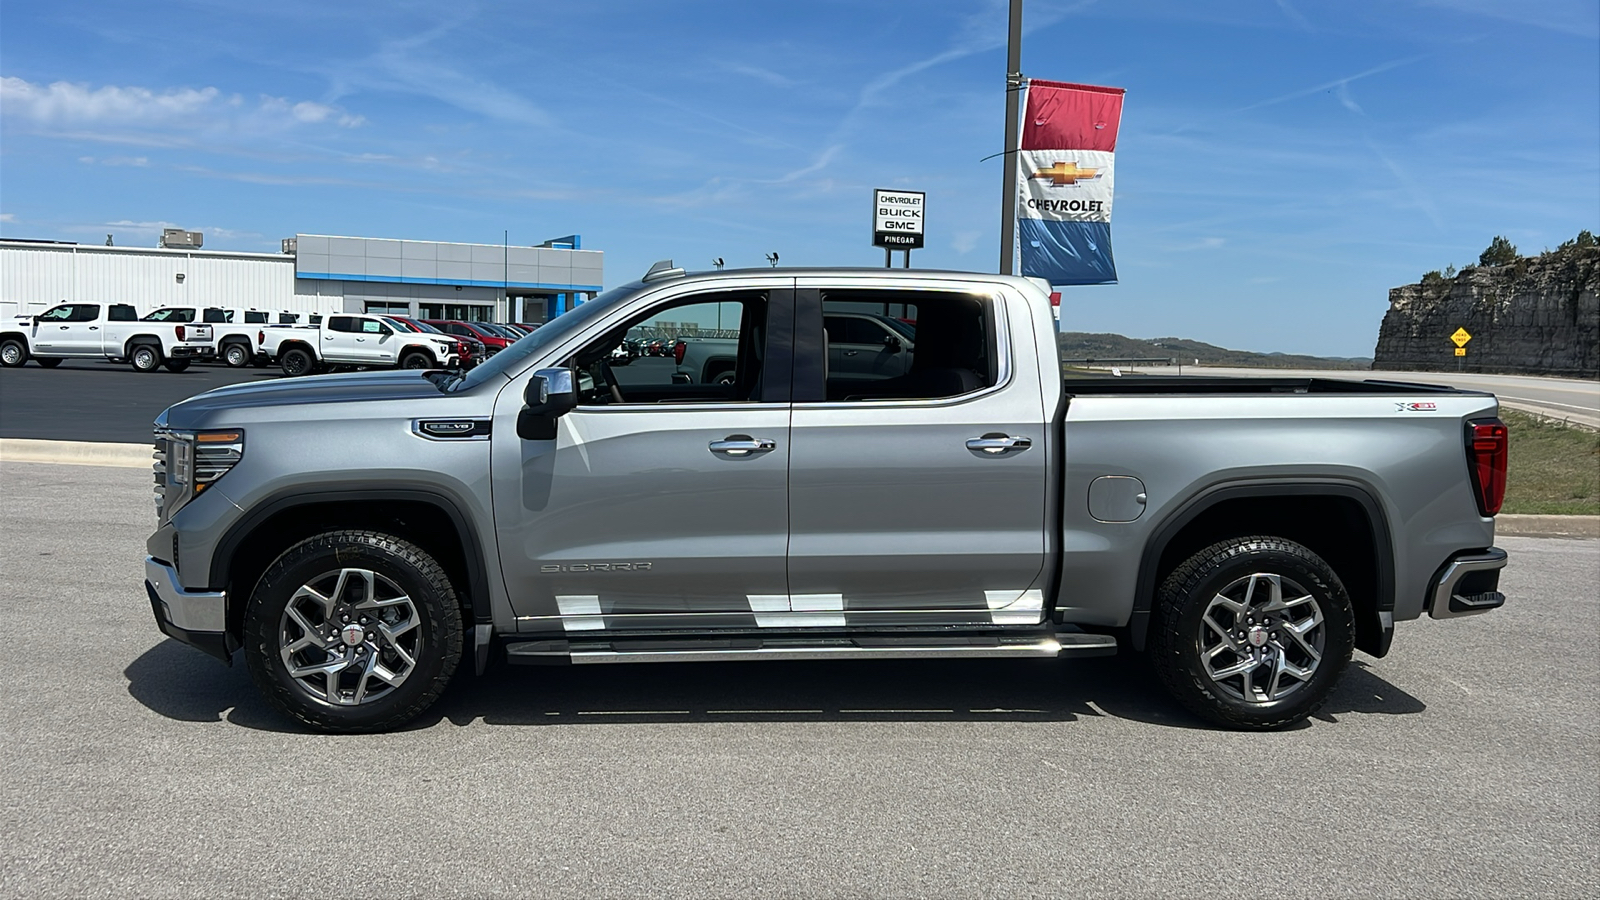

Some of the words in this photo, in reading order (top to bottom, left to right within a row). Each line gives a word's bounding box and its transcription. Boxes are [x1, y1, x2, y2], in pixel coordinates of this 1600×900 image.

[880, 195, 921, 205] CHEVROLET
[1027, 198, 1103, 212] CHEVROLET
[879, 208, 921, 217] BUICK
[885, 221, 915, 230] GMC
[884, 235, 915, 244] PINEGAR
[540, 561, 653, 573] SIERRA
